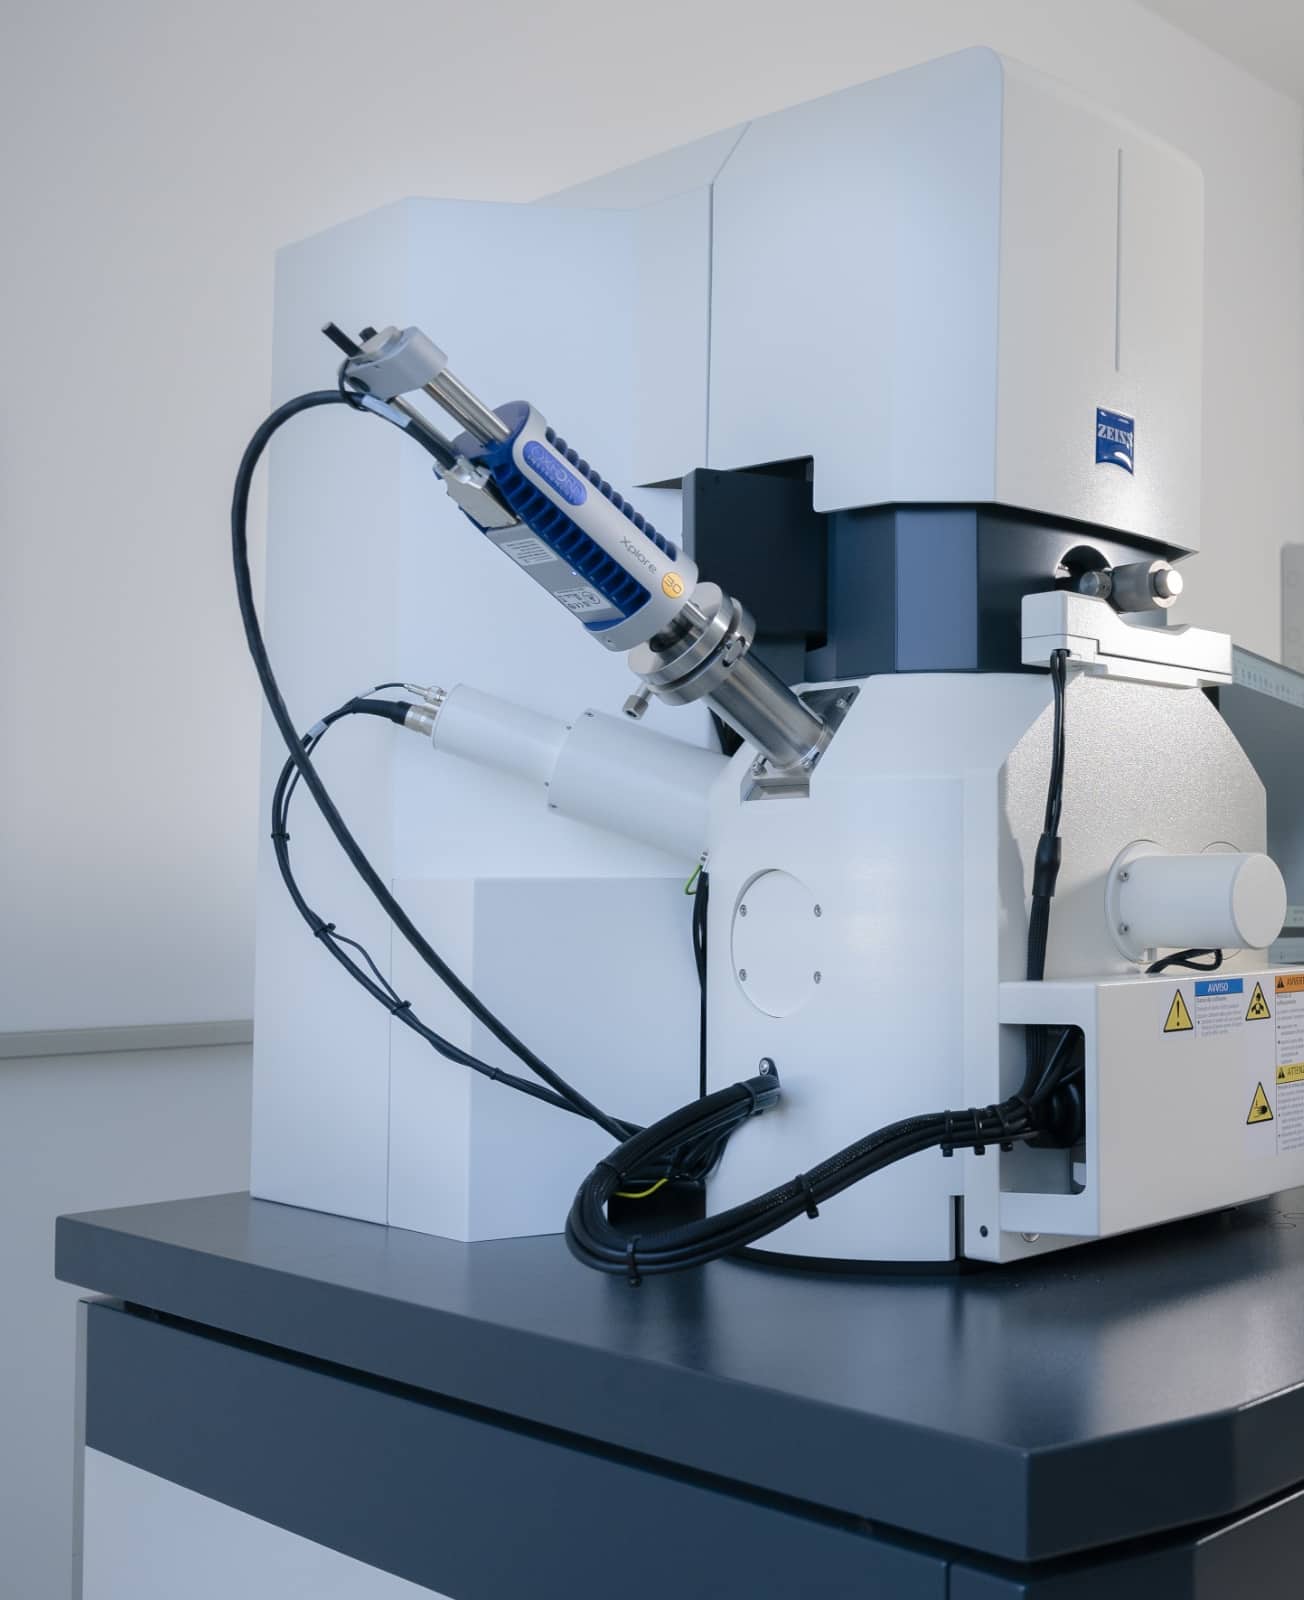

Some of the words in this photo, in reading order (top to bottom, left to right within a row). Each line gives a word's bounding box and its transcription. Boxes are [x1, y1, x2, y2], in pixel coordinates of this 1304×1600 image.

[1098, 423, 1133, 447] ZEISS
[619, 535, 657, 574] Xplore
[664, 576, 683, 595] 30
[1207, 982, 1229, 993] AVVISO
